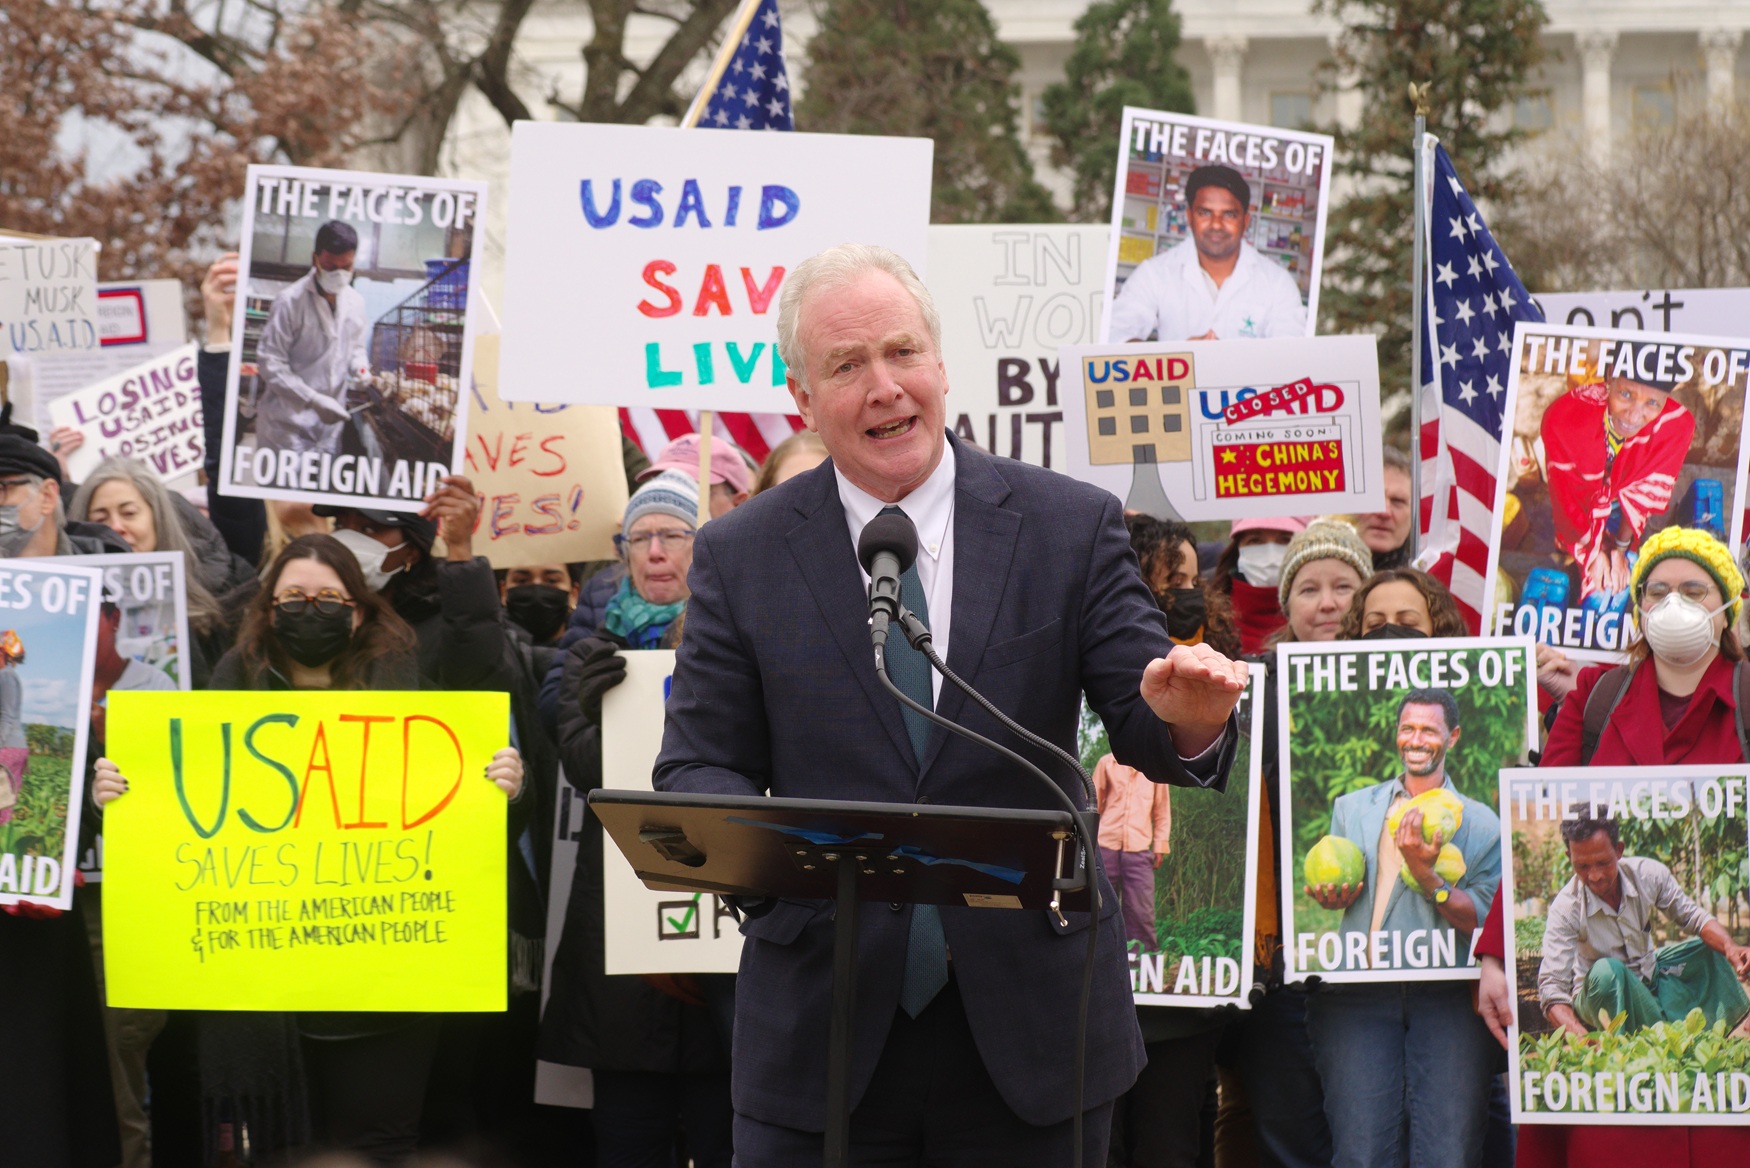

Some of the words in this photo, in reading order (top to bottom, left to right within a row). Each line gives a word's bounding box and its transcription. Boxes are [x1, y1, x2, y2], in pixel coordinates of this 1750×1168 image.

[1134, 119, 1189, 158] THE
[1195, 127, 1279, 170] FACES
[1285, 142, 1322, 176] OF
[259, 179, 320, 219] THE
[328, 183, 424, 226] FACES
[430, 193, 475, 230] OF
[580, 178, 800, 230] USAID
[992, 231, 1082, 287] IN
[24, 286, 87, 316] MUSK
[1536, 289, 1684, 334] on't
[997, 357, 1060, 408] BY
[1088, 358, 1190, 384] USAID
[1525, 335, 1589, 376] THE
[1597, 341, 1695, 383] FACES
[1703, 349, 1748, 388] OF
[73, 356, 195, 425] LOSING
[1226, 382, 1308, 420] CLOSED
[1215, 430, 1274, 442] COMING
[1256, 441, 1340, 468] CHINA'S
[233, 446, 381, 497] FOREIGN
[1218, 468, 1340, 496] HEGEMONY
[40, 576, 88, 615] OF
[131, 564, 171, 602] OF
[1290, 655, 1358, 692] THE
[1369, 651, 1470, 690] FACES
[1480, 649, 1523, 687] OF
[169, 713, 464, 839] USAID
[1512, 782, 1580, 821] THE
[1589, 779, 1691, 820] FACES
[1700, 778, 1744, 819] OF
[174, 841, 299, 891] SAVES
[314, 829, 433, 887] LIVES!
[196, 900, 249, 926] FROM
[258, 899, 292, 922] THE
[299, 894, 394, 923] AMERICAN
[400, 890, 456, 919] PEOPLE
[208, 928, 240, 954] FOR
[247, 926, 284, 951] THE
[289, 923, 376, 948] AMERICAN
[381, 920, 448, 946] PEOPLE
[1298, 927, 1457, 971] FOREIGN
[1173, 954, 1239, 996] AID
[1524, 1070, 1679, 1113] FOREIGN
[1690, 1071, 1750, 1111] AID
